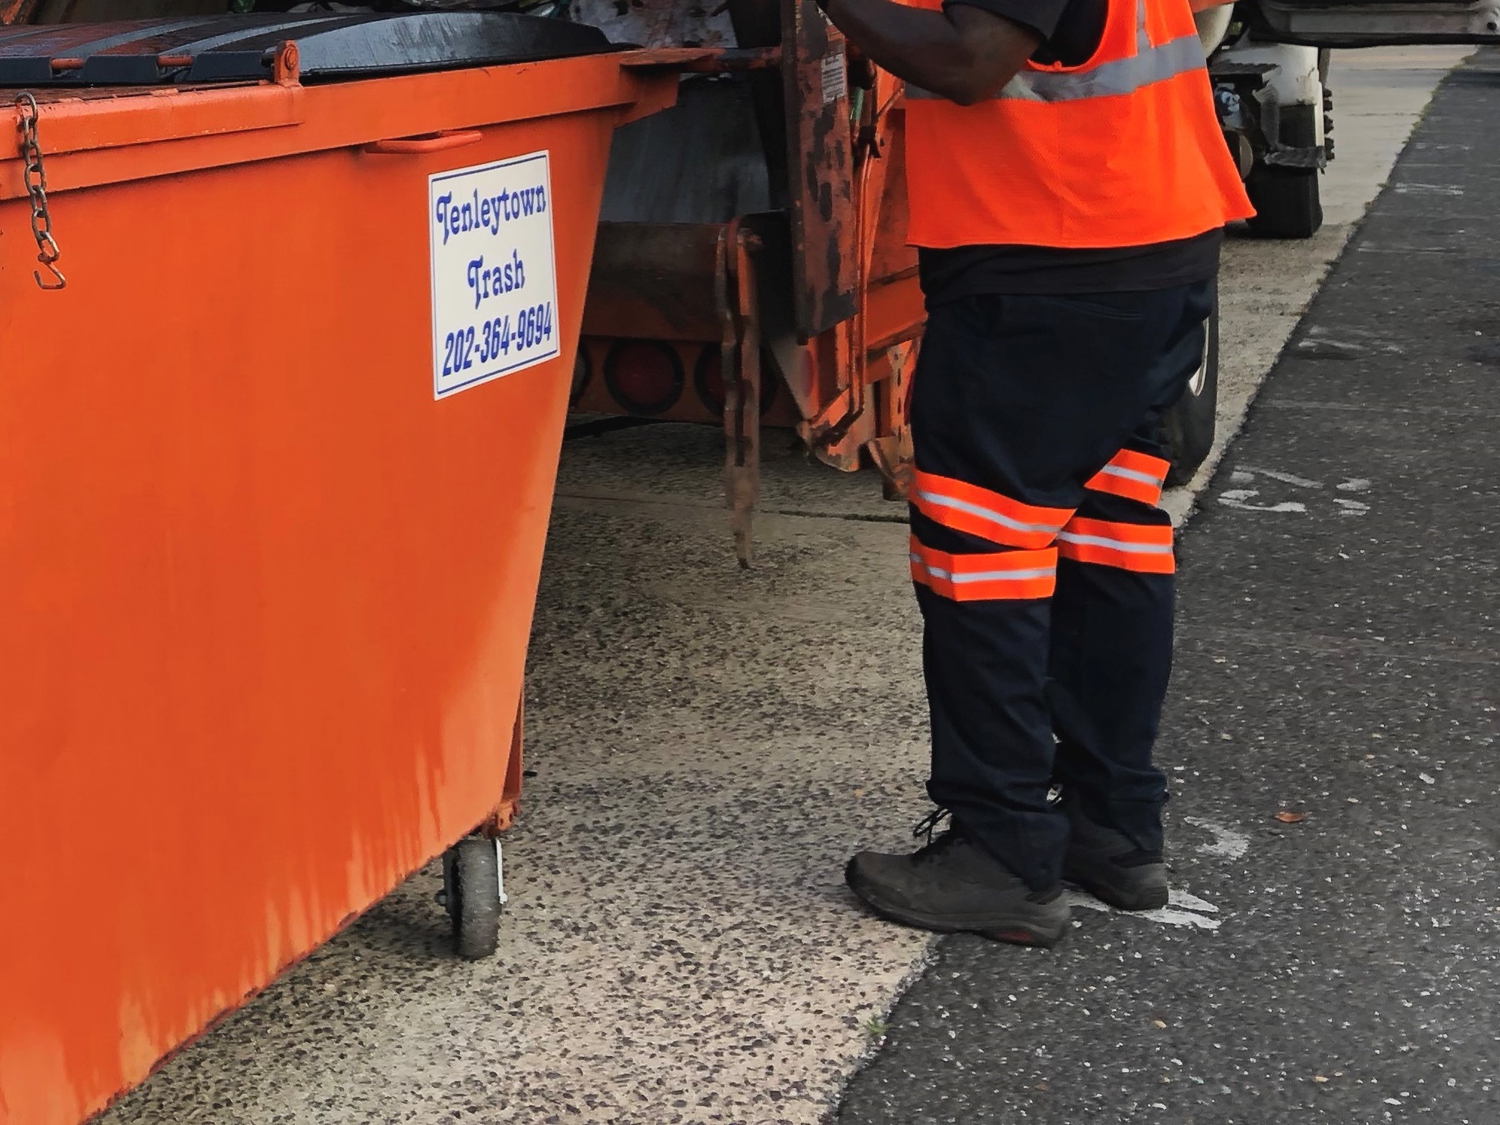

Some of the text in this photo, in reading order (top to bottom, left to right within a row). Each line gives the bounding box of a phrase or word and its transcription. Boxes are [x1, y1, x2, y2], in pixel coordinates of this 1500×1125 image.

[436, 183, 547, 246] Tenleytown
[467, 248, 526, 310] Trash
[442, 301, 552, 377] 202-364-9694
